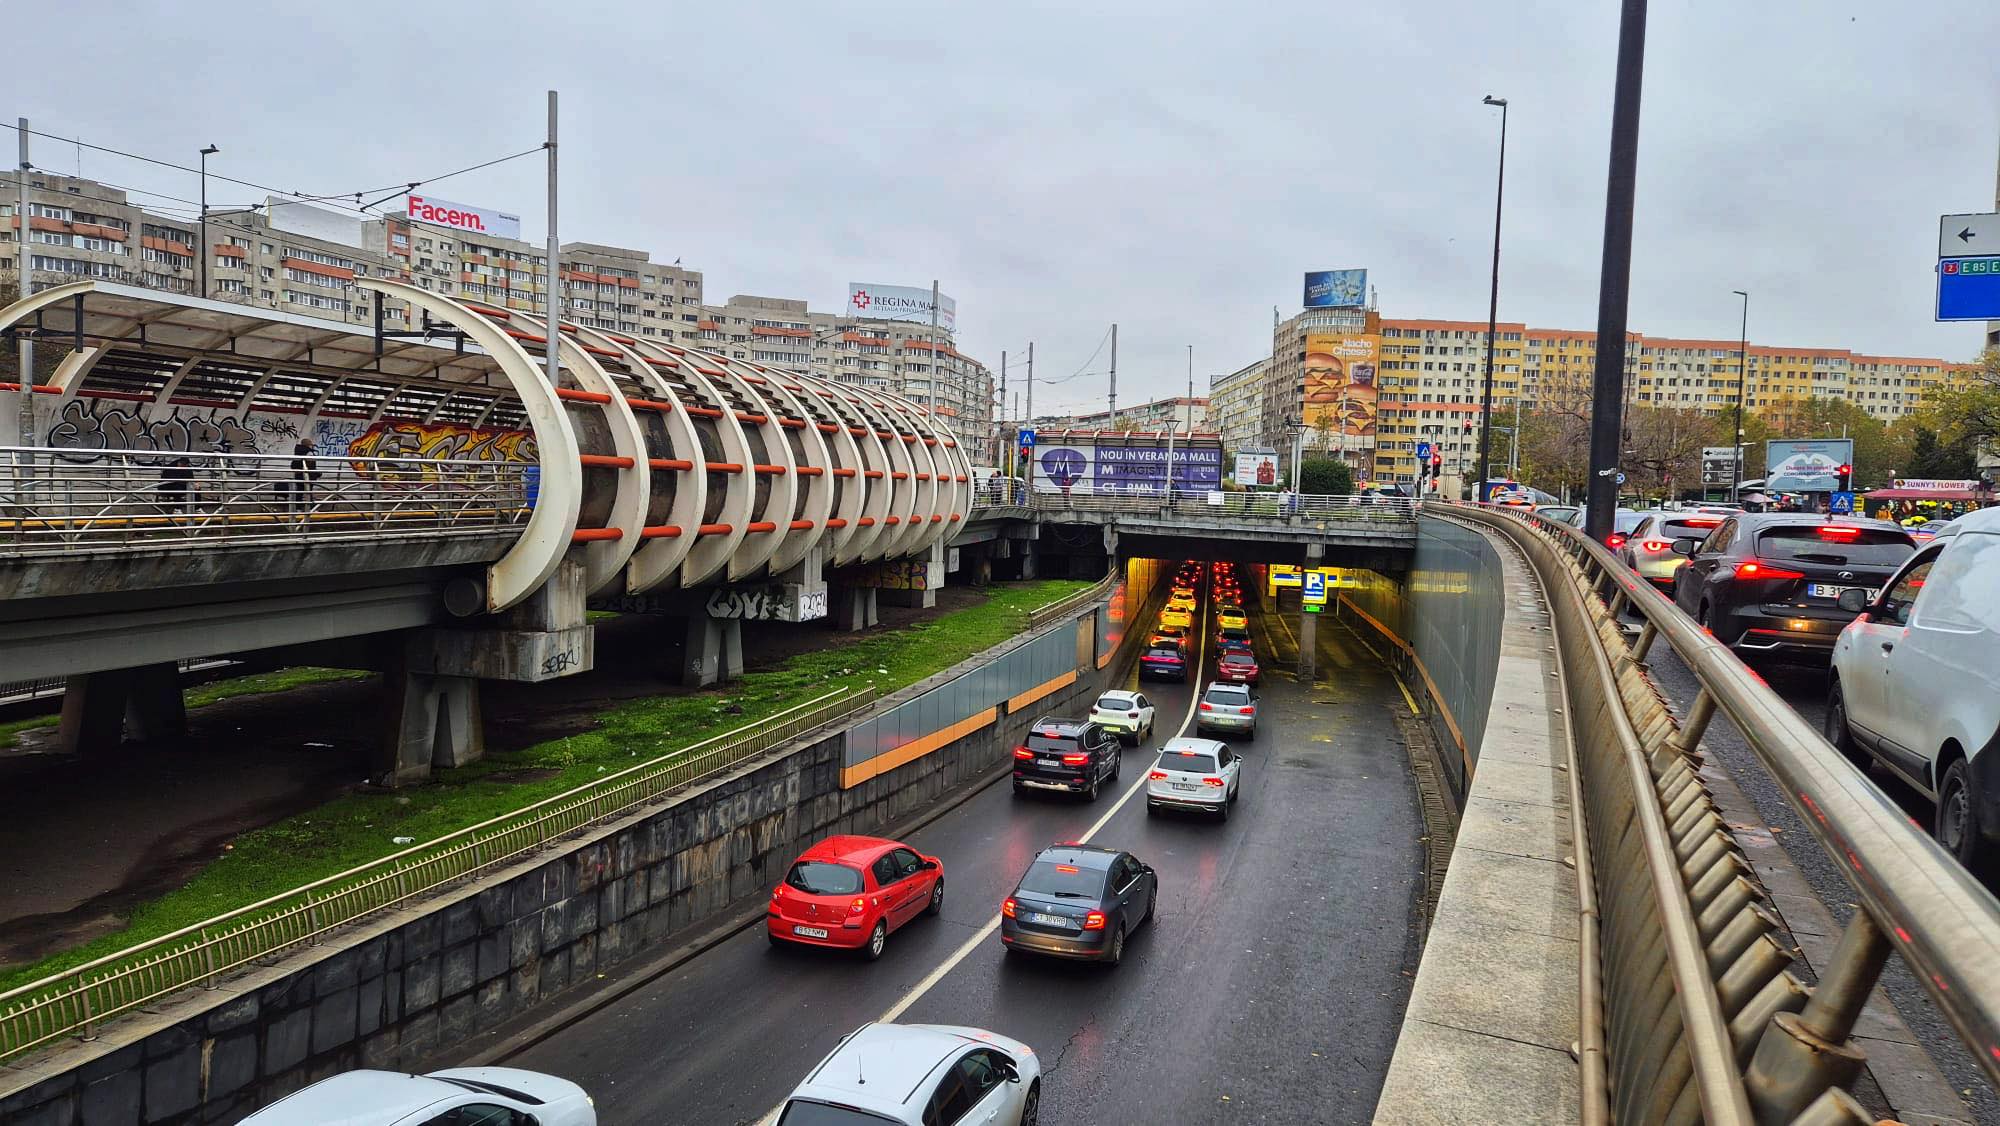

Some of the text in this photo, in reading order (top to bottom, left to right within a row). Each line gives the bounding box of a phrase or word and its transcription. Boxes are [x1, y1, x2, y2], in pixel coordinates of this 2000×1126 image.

[408, 195, 485, 230] Facem.
[1947, 264, 1953, 272] 2
[1962, 262, 1986, 272] E 85
[874, 296, 916, 308] REGINA
[1100, 448, 1217, 462] NOU ÎN VERANDA MALL
[1937, 481, 1965, 489] FLOWER
[1815, 585, 1825, 595] B
